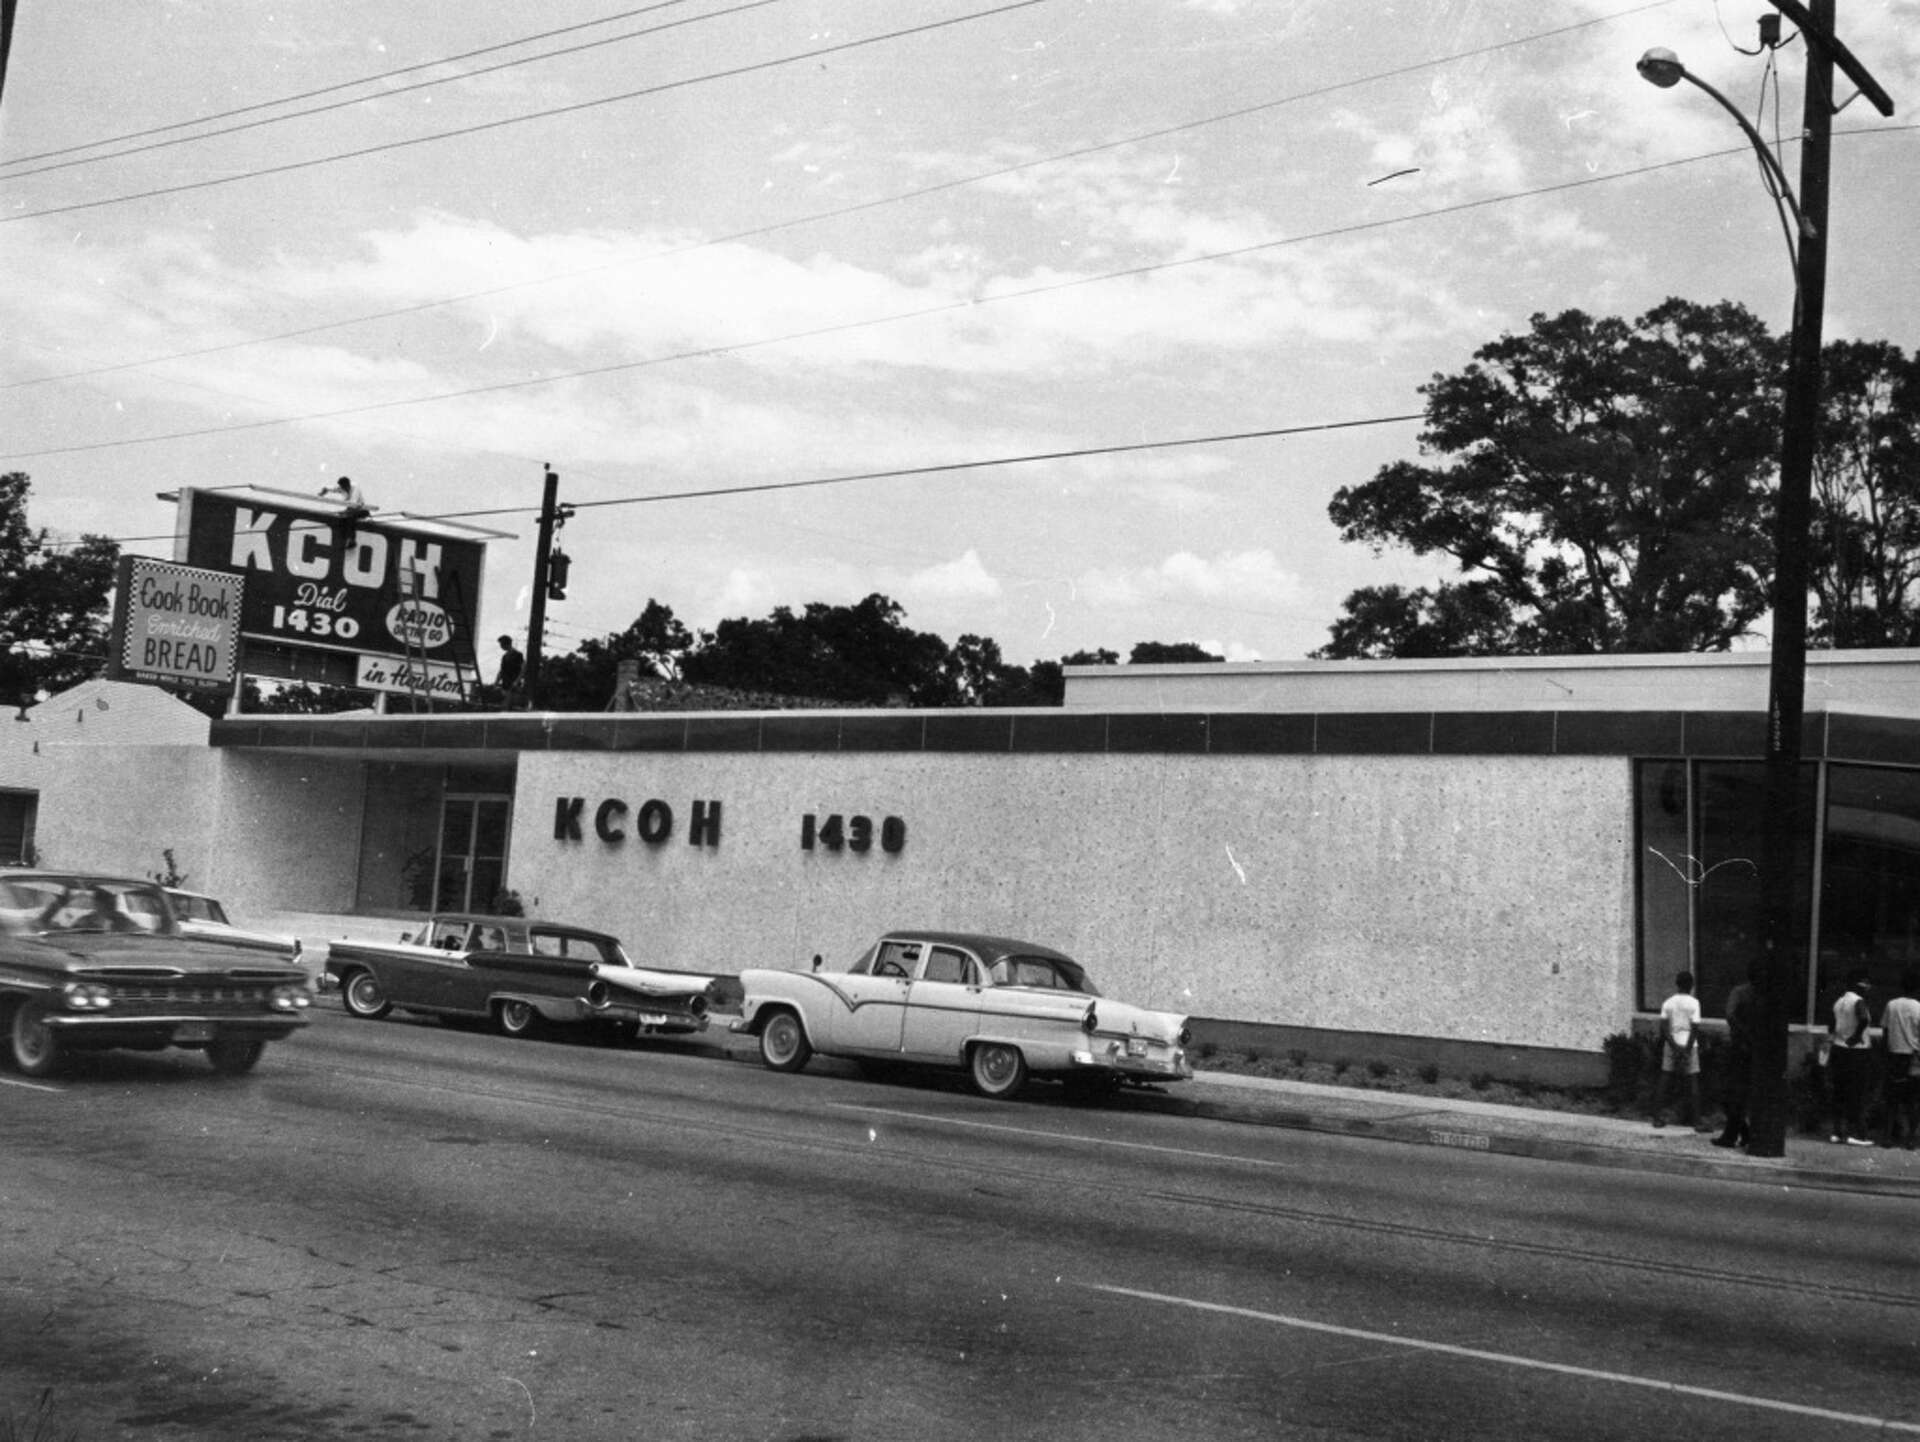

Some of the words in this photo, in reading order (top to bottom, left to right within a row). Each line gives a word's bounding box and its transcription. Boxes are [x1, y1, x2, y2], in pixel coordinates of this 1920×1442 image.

[231, 507, 443, 599] KCOH
[140, 577, 184, 613] Cook
[188, 583, 230, 620] Book
[293, 582, 348, 613] Dial
[147, 614, 221, 643] Enriched
[273, 605, 360, 639] 1430
[395, 607, 447, 628] RADIO
[144, 637, 217, 674] BREAD
[361, 662, 386, 684] in
[554, 797, 722, 847] KCOH
[801, 813, 907, 854] 1430
